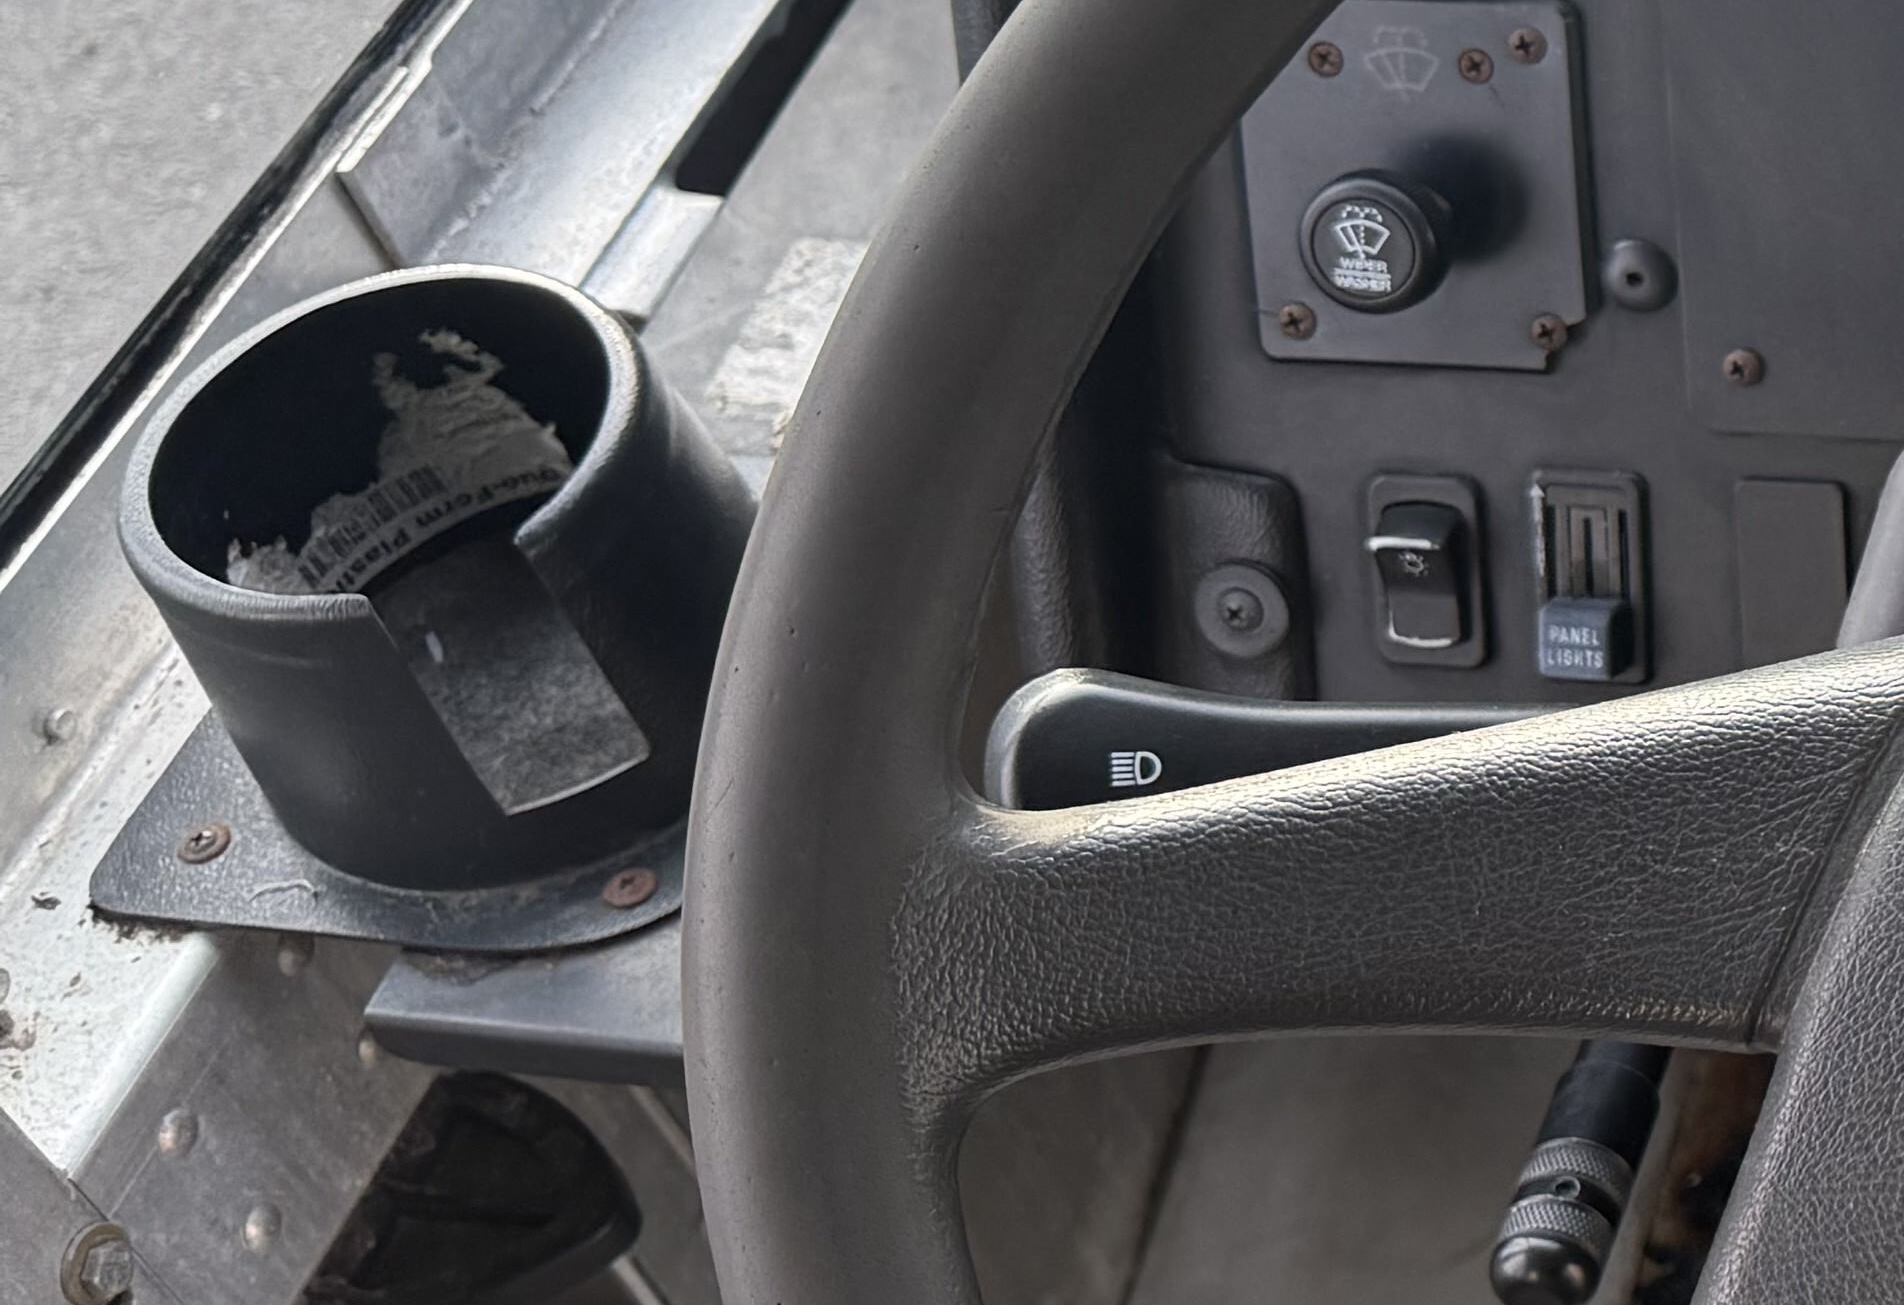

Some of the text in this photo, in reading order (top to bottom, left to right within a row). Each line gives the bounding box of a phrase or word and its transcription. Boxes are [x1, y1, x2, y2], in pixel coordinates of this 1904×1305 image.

[1339, 257, 1388, 274] WIPER
[1547, 623, 1600, 645] PANEL
[1547, 649, 1605, 670] LIGHTS
